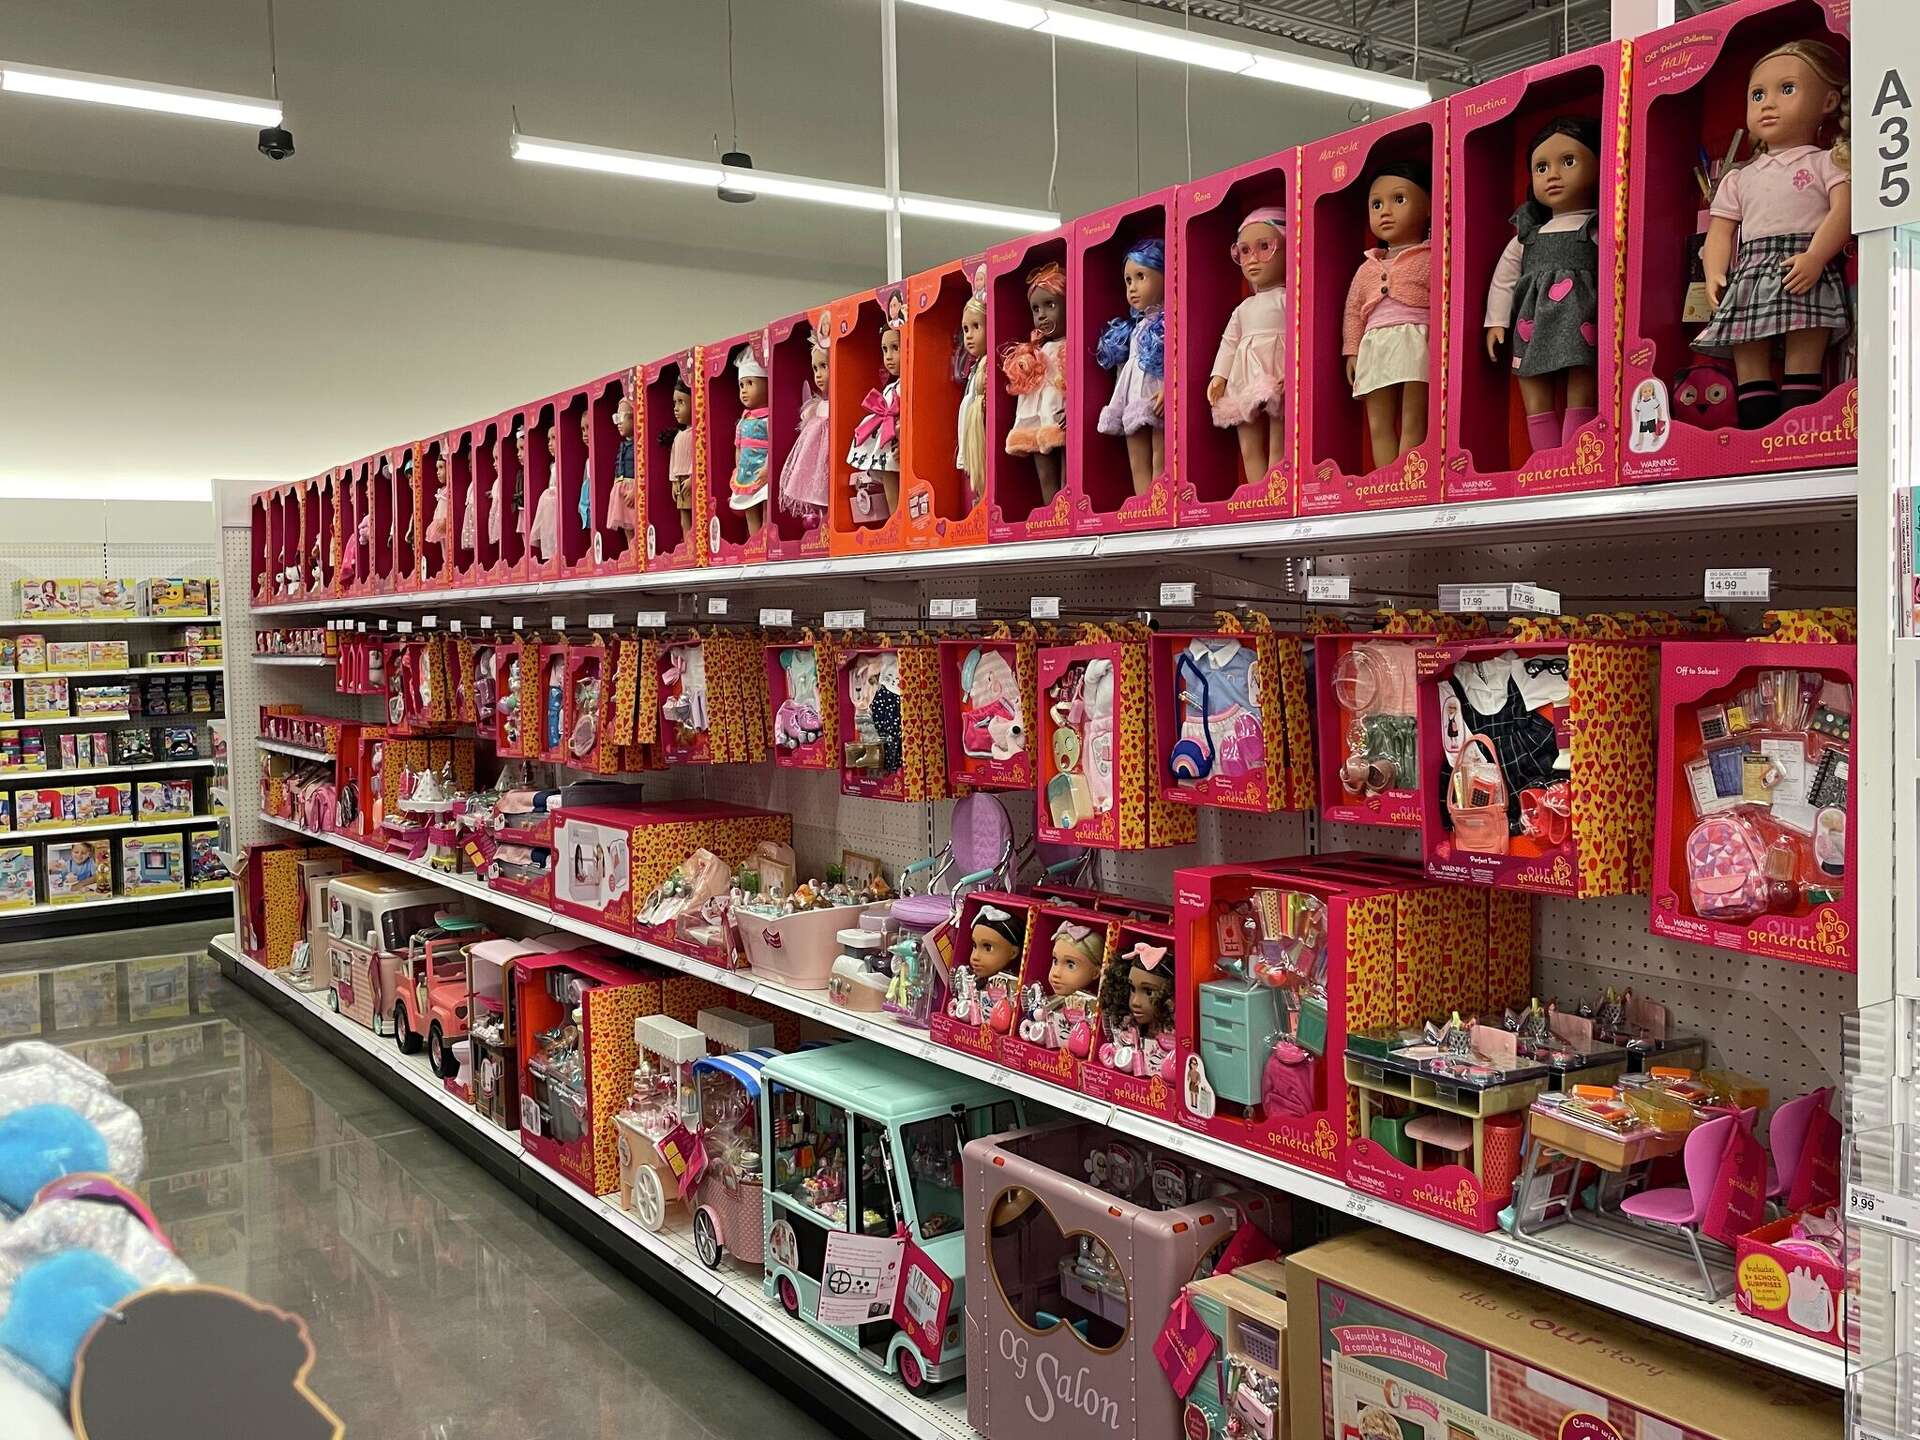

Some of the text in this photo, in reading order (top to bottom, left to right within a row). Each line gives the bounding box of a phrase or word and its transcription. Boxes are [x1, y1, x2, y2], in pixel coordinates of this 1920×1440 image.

[1464, 96, 1508, 117] Martina
[1761, 424, 1858, 455] generati
[1517, 461, 1605, 488] generation
[1355, 479, 1428, 501] generation
[1227, 496, 1289, 515] generation
[1116, 506, 1169, 524] generation
[1025, 517, 1071, 532] generation
[1311, 586, 1330, 594] 12.99
[1710, 580, 1737, 590] 14.99
[1462, 597, 1483, 606] 17.99
[1513, 592, 1535, 605] 17.99
[1675, 666, 1719, 676] Off to School
[1390, 812, 1423, 823] genera
[1517, 872, 1573, 887] generation
[1766, 920, 1809, 937] our
[1747, 929, 1850, 957] generation
[953, 1033, 993, 1053] generation
[1027, 1058, 1073, 1080] generation
[1114, 1087, 1167, 1111] generation
[1267, 1131, 1337, 1162] generation
[1346, 1199, 1367, 1213] 29.99
[1412, 1187, 1478, 1218] generation
[1850, 1195, 1875, 1211] 9.99
[1495, 1252, 1521, 1268] 24.99
[1458, 1289, 1498, 1312] this
[1505, 1308, 1523, 1321] is
[1598, 1346, 1665, 1377] story
[1730, 1333, 1754, 1350] 7.99
[1343, 1329, 1432, 1357] Assemble 3 walls into
[1352, 1340, 1388, 1355] complete
[1389, 1346, 1441, 1373] schoolroom!
[999, 1328, 1030, 1380] OG
[1024, 1351, 1121, 1431] Salon
[1572, 1417, 1599, 1432] Comes
